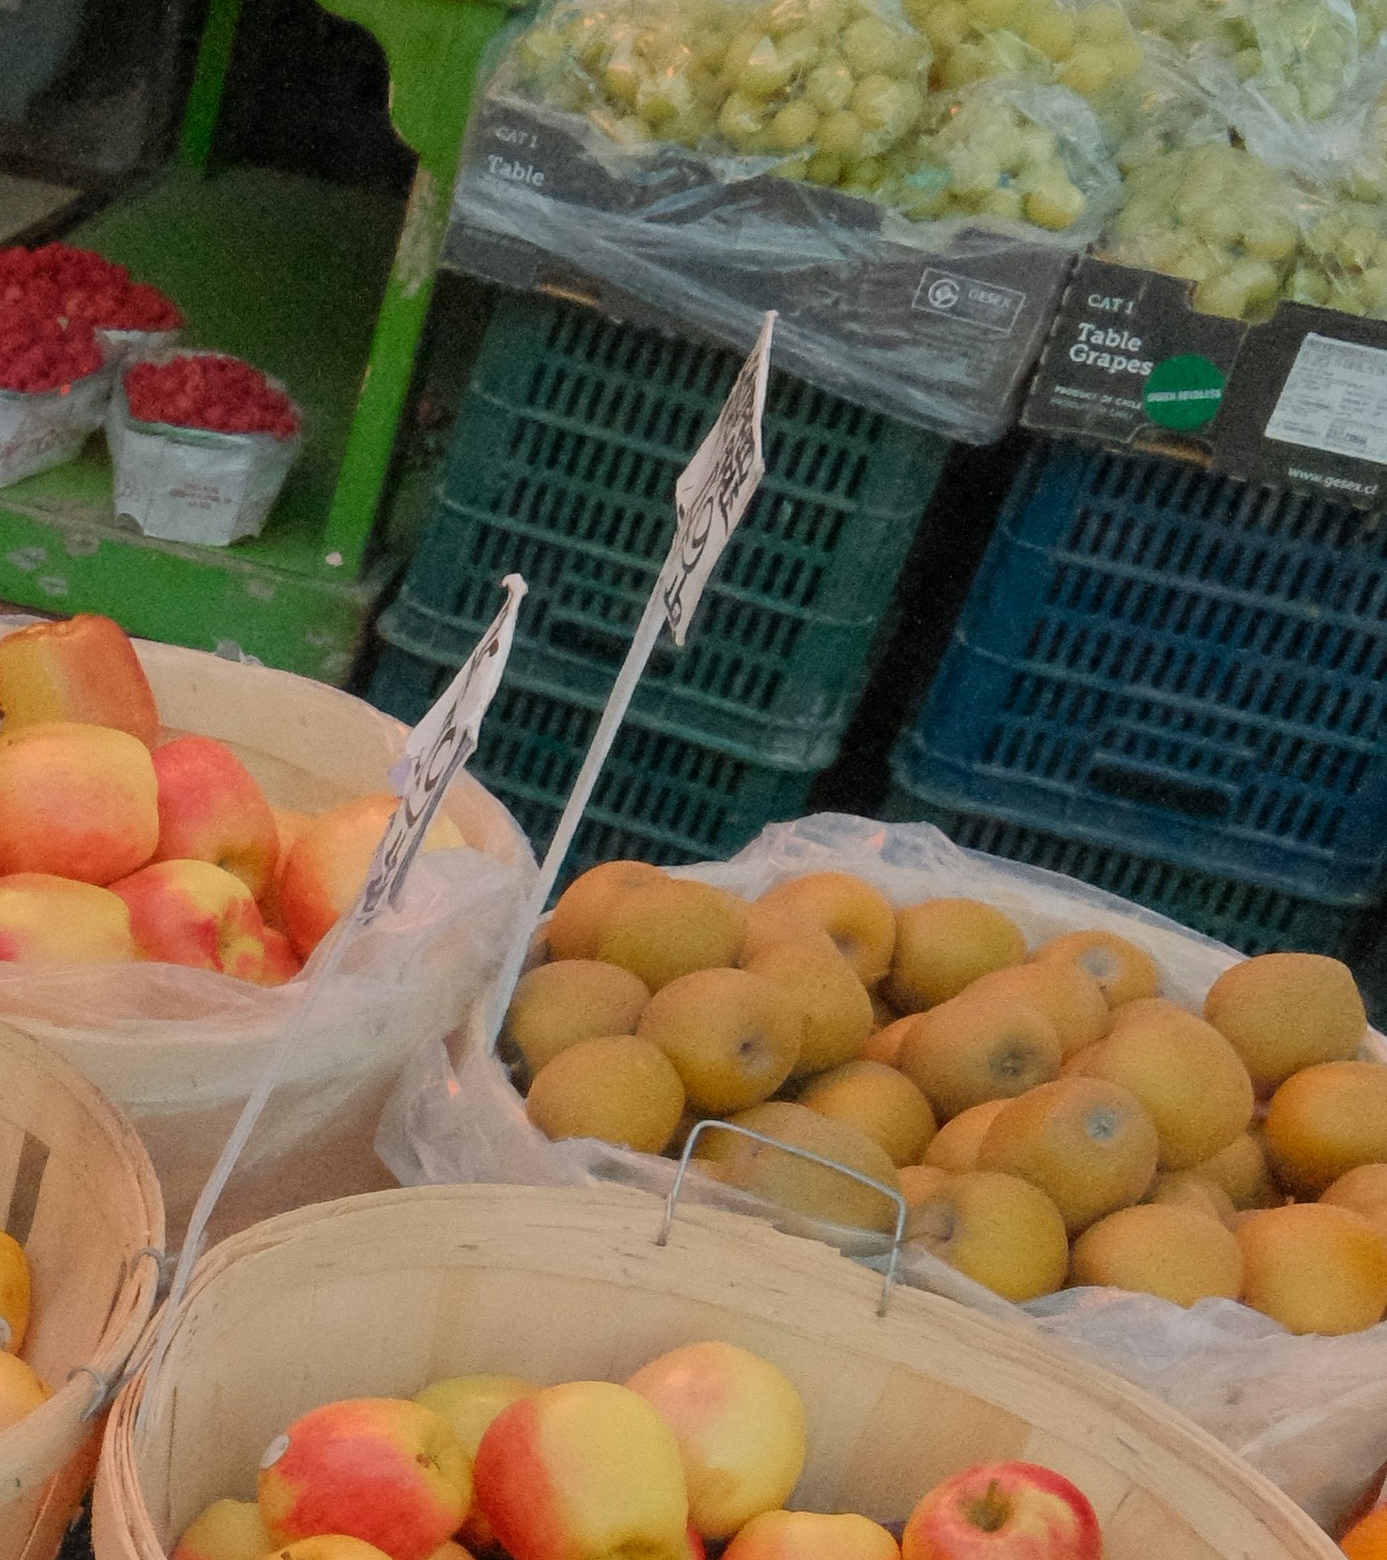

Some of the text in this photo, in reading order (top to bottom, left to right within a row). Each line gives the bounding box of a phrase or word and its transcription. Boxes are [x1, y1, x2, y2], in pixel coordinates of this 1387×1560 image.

[487, 153, 546, 190] Table
[1087, 293, 1119, 313] CAT
[1078, 322, 1143, 352] Table
[1069, 343, 1155, 376] Grapes
